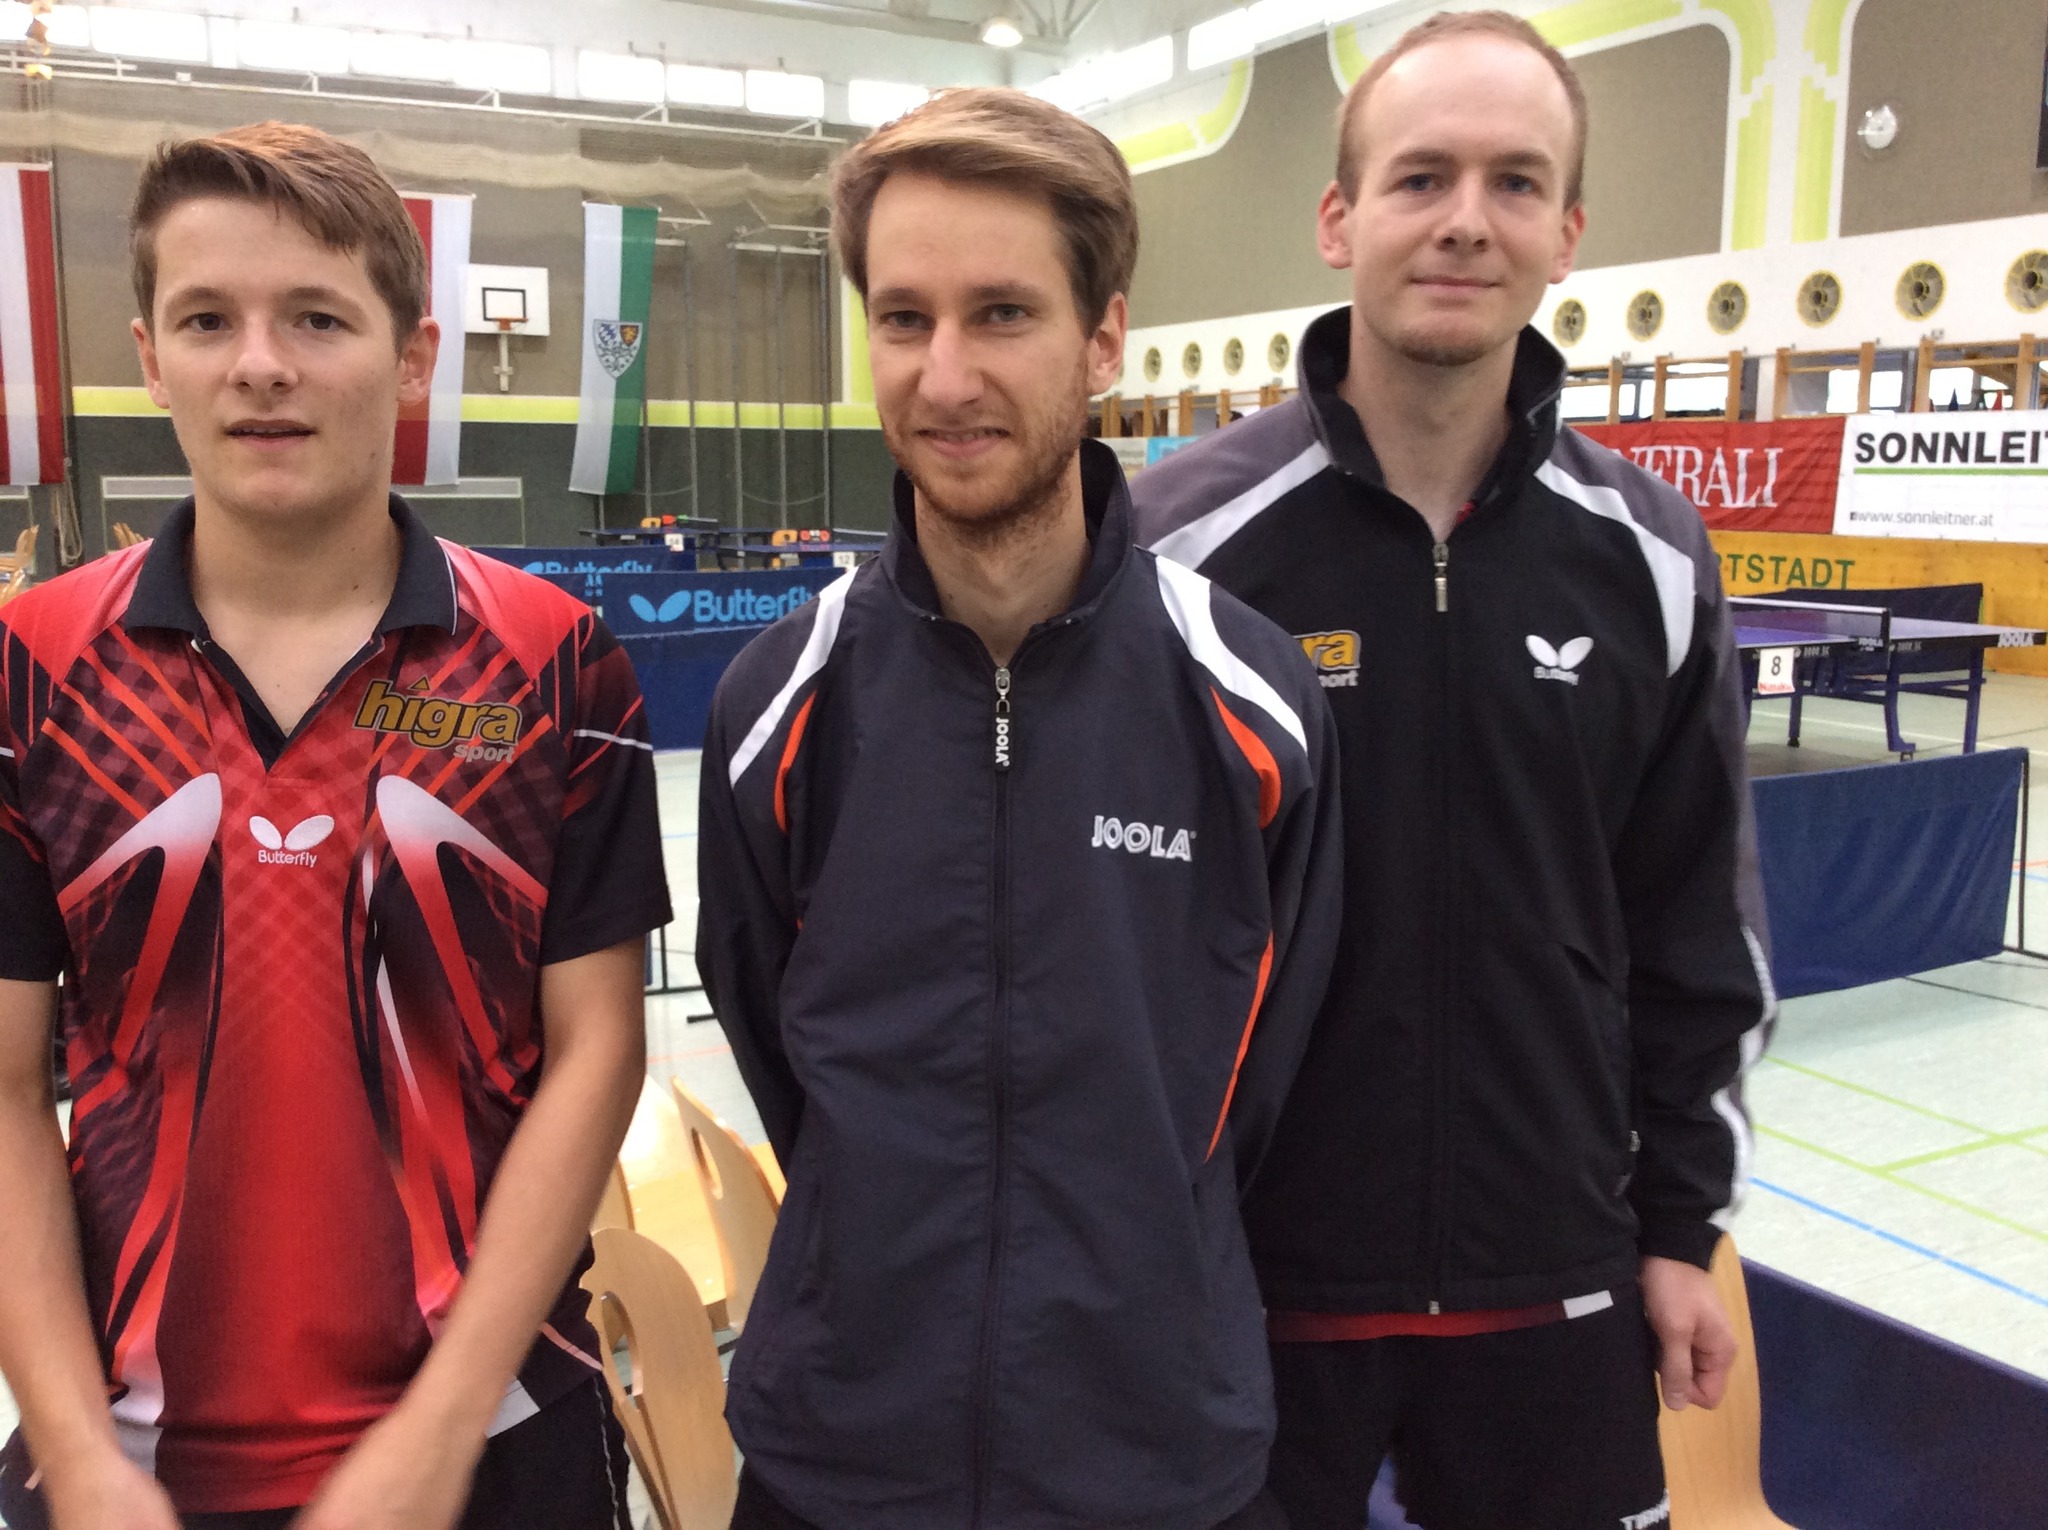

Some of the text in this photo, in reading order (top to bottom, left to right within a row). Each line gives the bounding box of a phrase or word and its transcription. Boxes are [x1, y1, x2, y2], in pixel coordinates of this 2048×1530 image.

[1855, 430, 2048, 464] SONNLEI
[1612, 445, 1783, 508] ERALI
[1857, 511, 1993, 527] www.sonnleitner.at
[1717, 552, 1855, 590] TSTADT
[693, 585, 814, 622] Butterfl
[1293, 630, 1361, 671] ra
[1770, 655, 1782, 676] 8
[1318, 669, 1358, 688] ort
[353, 675, 522, 750] higra
[453, 743, 515, 763] sport
[258, 850, 317, 868] Butterfly
